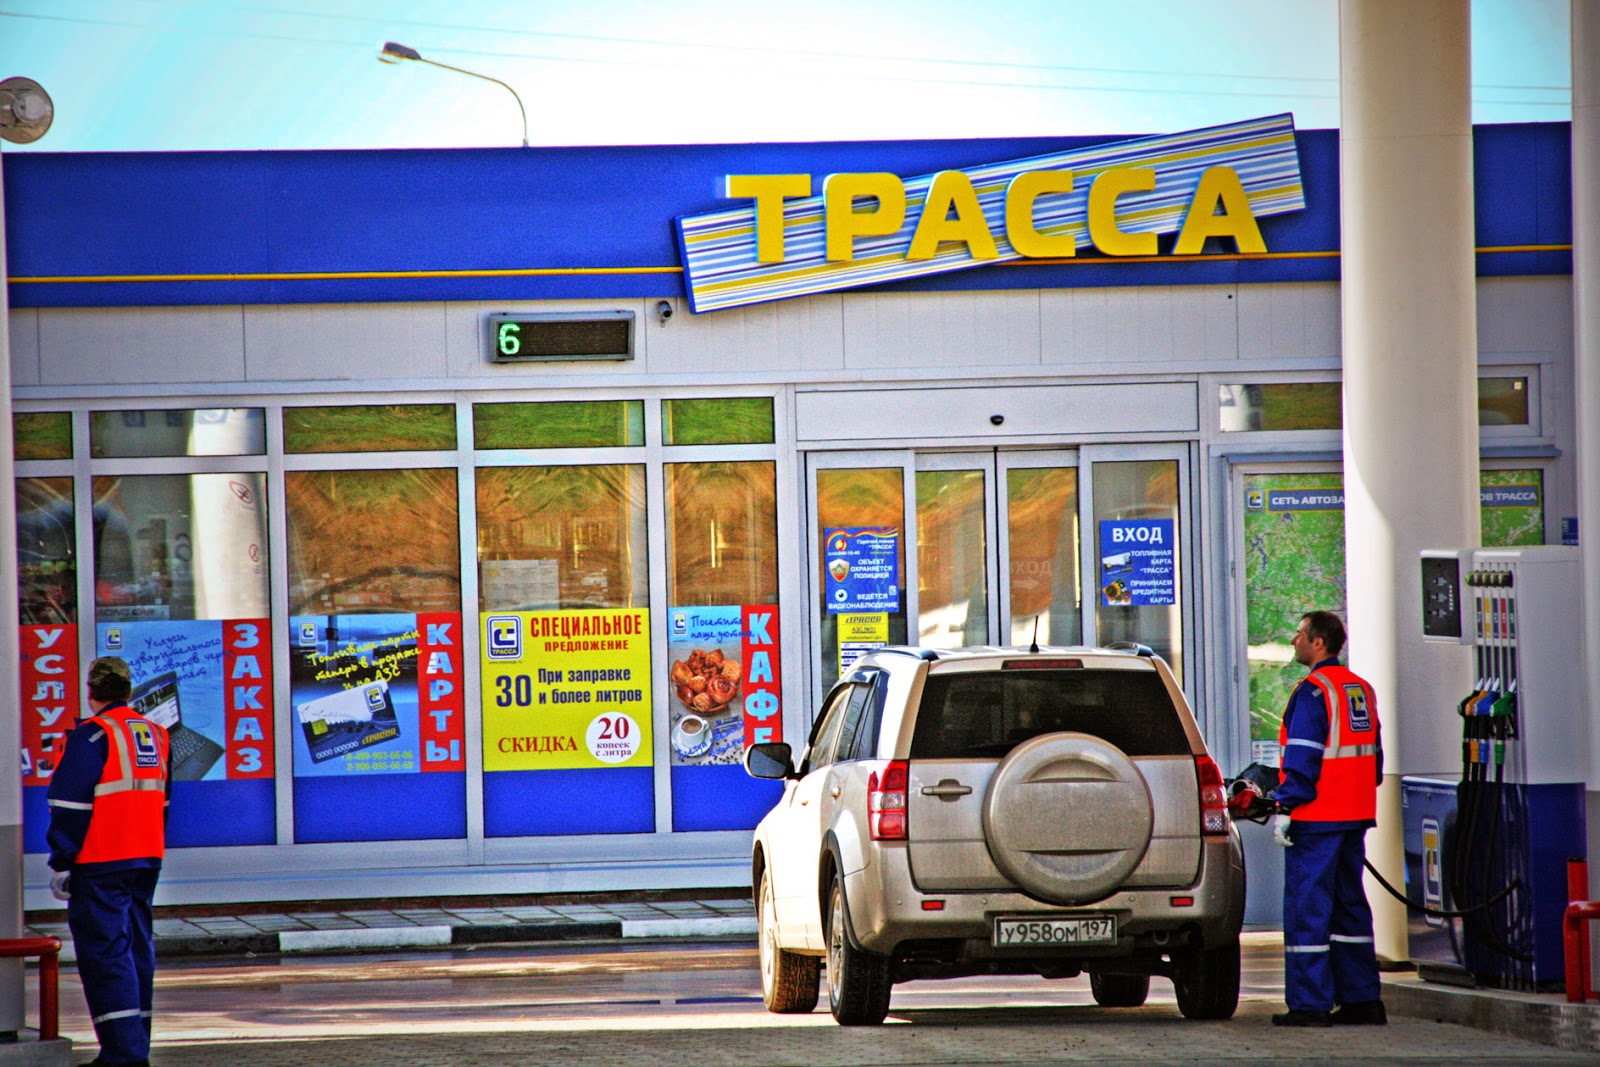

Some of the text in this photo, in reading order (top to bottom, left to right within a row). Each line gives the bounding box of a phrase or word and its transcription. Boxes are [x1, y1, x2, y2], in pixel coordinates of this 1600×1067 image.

[724, 166, 1268, 263] ТРАССА
[499, 323, 521, 355] 6
[1272, 496, 1345, 505] СЕТЬ АВТОЗА
[1495, 492, 1537, 501] ТРАССА
[1112, 527, 1163, 544] ВХОД
[530, 614, 642, 639] СПЕЦИАЛЬНОЕ
[690, 615, 744, 628] Посетите
[144, 634, 187, 650] Услуги
[690, 632, 716, 640] наше
[128, 638, 222, 668] едварительного
[306, 630, 421, 667] Топливные карты
[545, 640, 629, 653] ПРЕДЛОЖЕНИЕ
[315, 662, 358, 682] теперь
[371, 647, 423, 669] продаже
[375, 665, 401, 683] АЗС
[538, 668, 631, 685] При заправке
[231, 624, 265, 773] ЗАКАЗ
[426, 623, 460, 762] КАРТЫ
[496, 675, 532, 707] 30
[539, 688, 642, 704] и более литров
[597, 716, 630, 740] 20
[1352, 720, 1369, 728] ТРАССА
[498, 735, 578, 755] СКИДКА
[602, 749, 632, 758] литра
[137, 756, 157, 764] ТРАССА
[1005, 921, 1108, 942] У958ОМ 197
